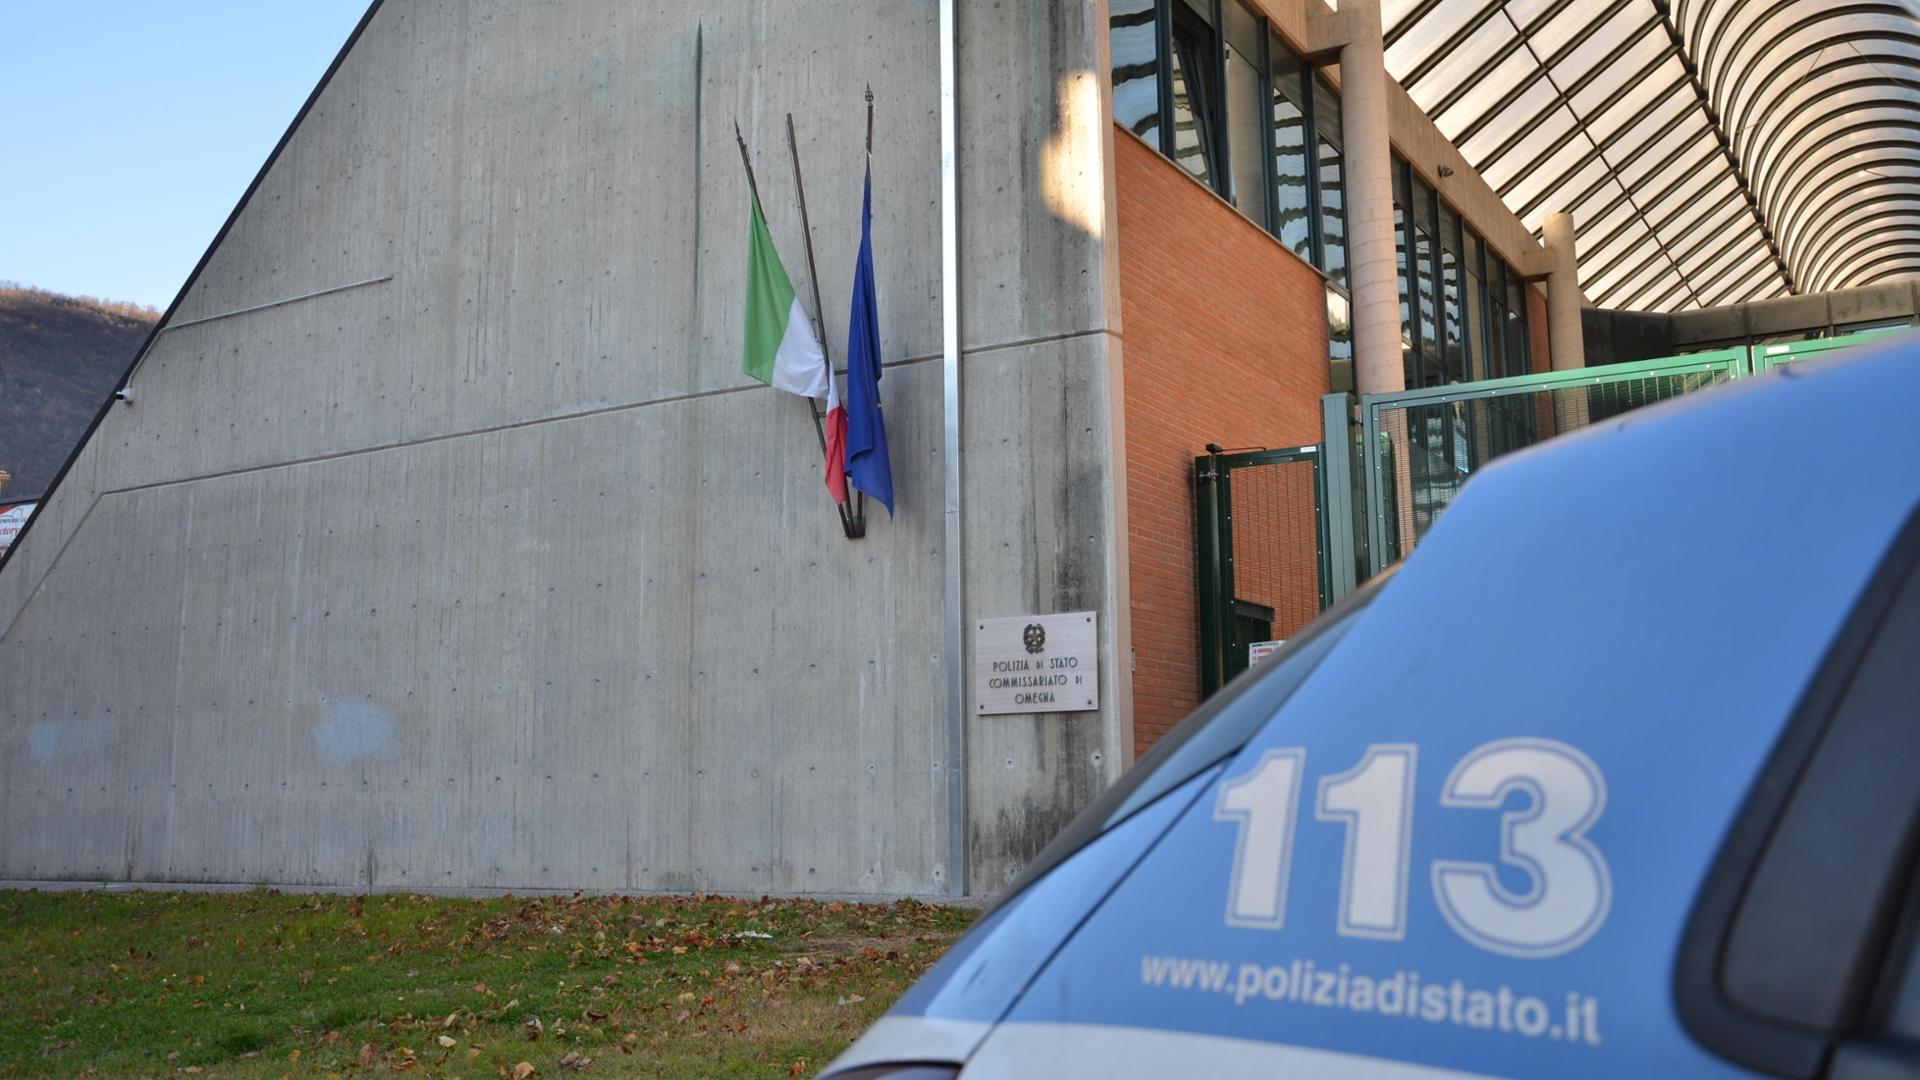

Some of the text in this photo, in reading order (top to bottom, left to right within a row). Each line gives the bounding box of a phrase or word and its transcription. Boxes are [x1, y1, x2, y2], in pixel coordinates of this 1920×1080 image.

[993, 660, 1030, 672] POLIZIA
[1050, 657, 1078, 669] STATO
[988, 674, 1068, 689] COMMISSARIATO
[1015, 692, 1055, 704] OMEGNA
[1213, 737, 1613, 959] 113
[1140, 954, 1602, 1046] www.poliziadistato.it
